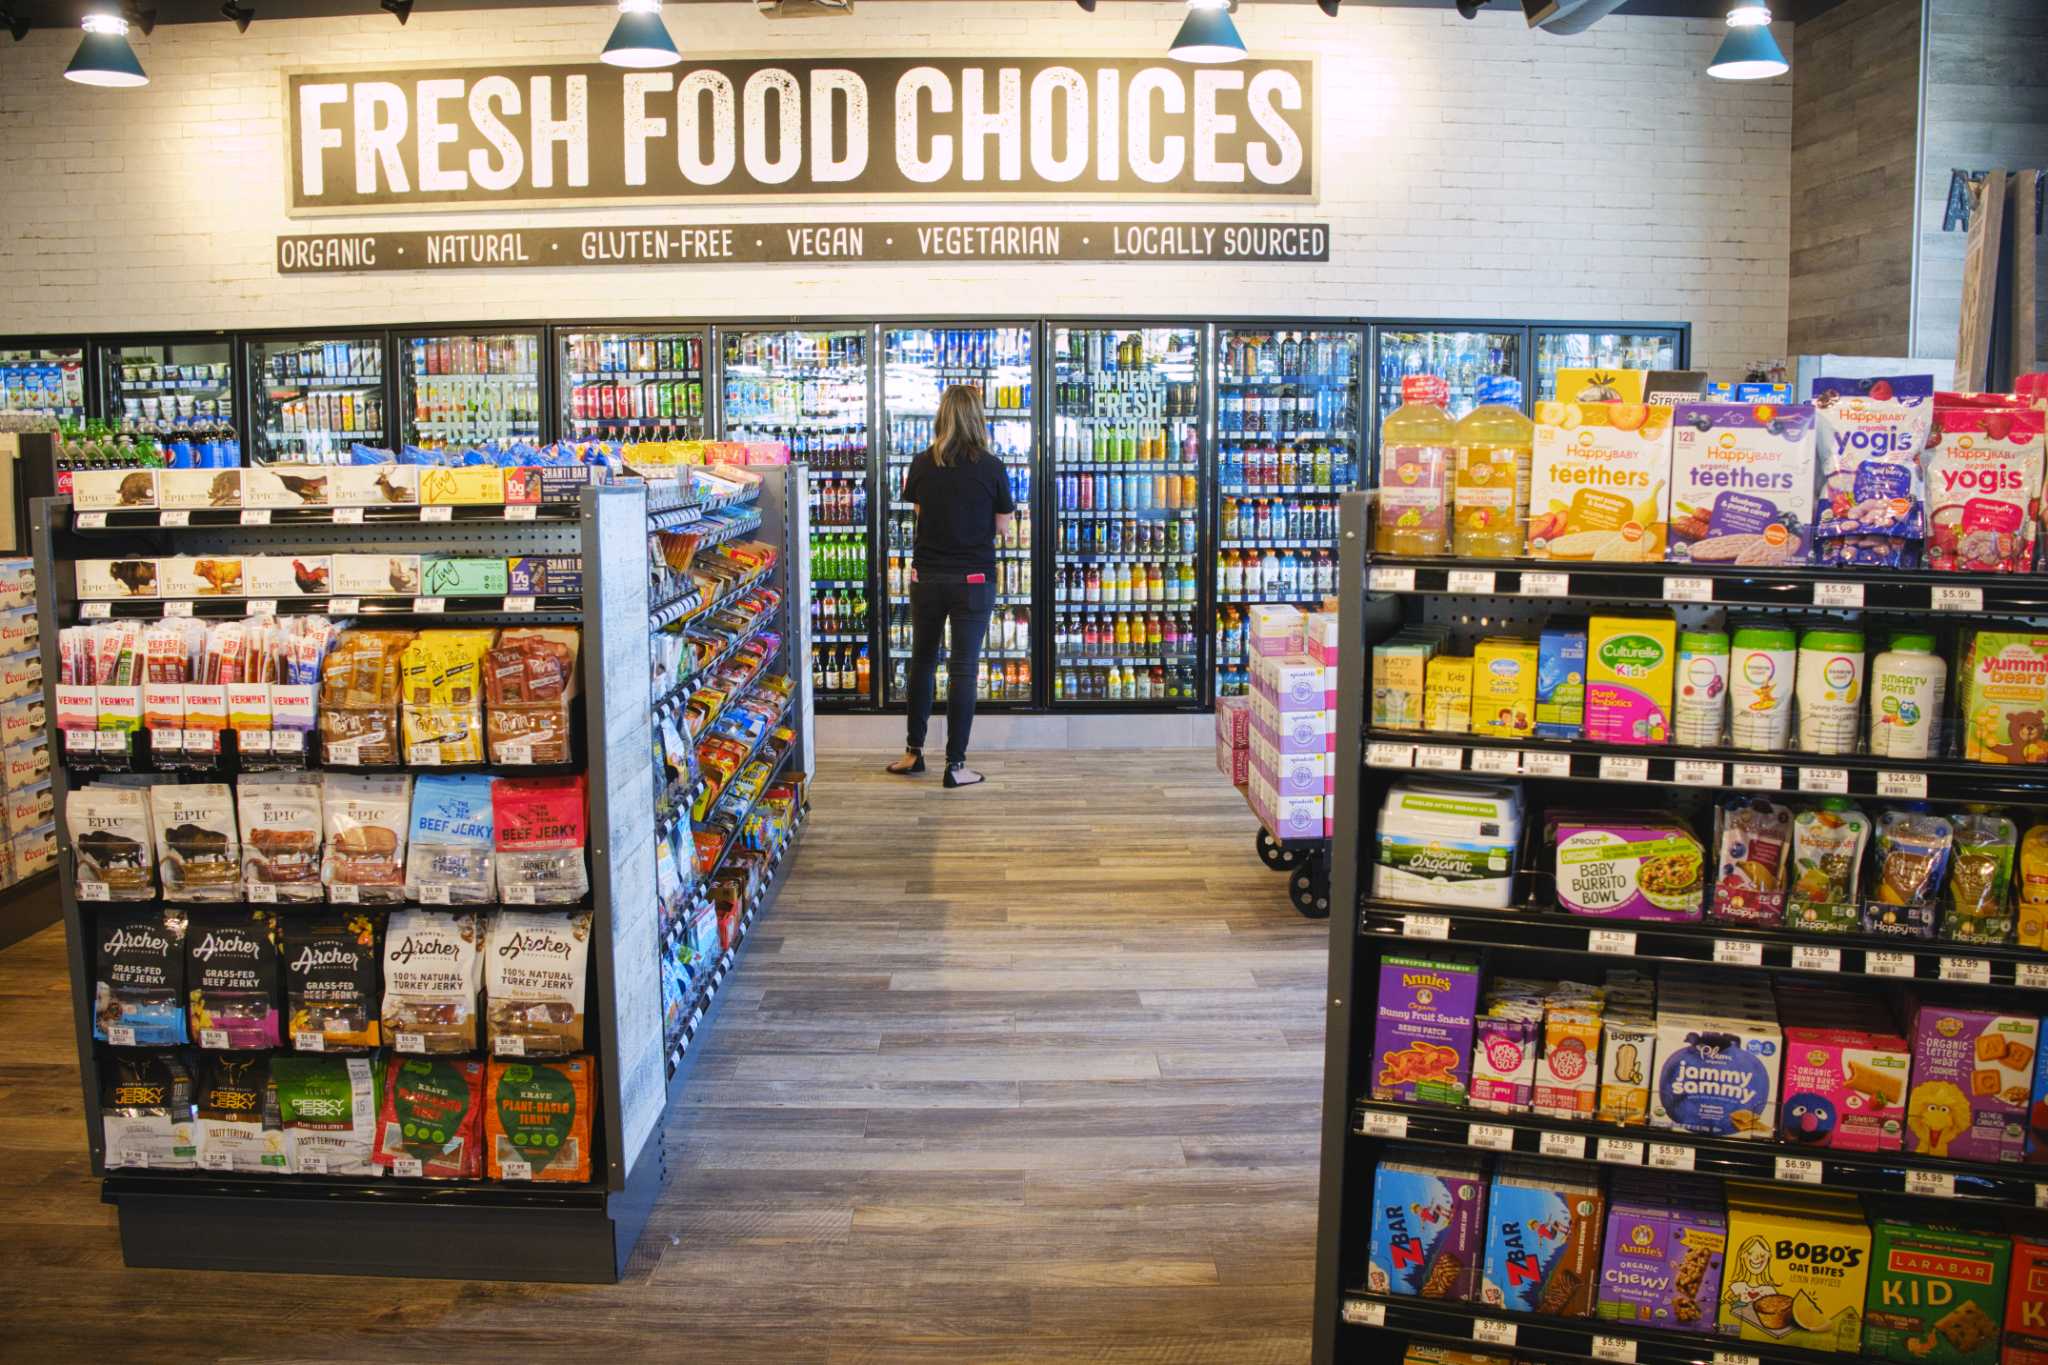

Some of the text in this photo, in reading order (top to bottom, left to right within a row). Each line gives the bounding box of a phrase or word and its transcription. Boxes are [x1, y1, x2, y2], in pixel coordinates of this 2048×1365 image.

[300, 67, 1303, 195] FRESH FOOD CHOICES
[281, 226, 1325, 268] ORGANIC NATURAL GLUTEN-FREE VEGAN VEGETARIAN LOCALLY SOURCED
[1095, 370, 1161, 391] IN HERE
[1094, 392, 1161, 418] FRESH
[1094, 419, 1161, 440] IS GOOD
[1833, 425, 1913, 457] yogis
[542, 467, 588, 479] SHANTI BAR
[1549, 464, 1649, 486] teethers
[1689, 466, 1793, 488] teethers
[1941, 463, 2023, 494] yogis
[507, 480, 525, 496] 10g
[547, 559, 575, 571] SHANTI
[1824, 585, 1852, 594] $5.99
[1942, 590, 1970, 598] $5.99
[1602, 644, 1660, 659] Culturelle
[1615, 664, 1647, 678] Kids
[1881, 674, 1927, 686] SMARTY
[1990, 671, 2046, 685] bears
[1881, 684, 1915, 695] PANTS
[1887, 773, 1922, 783] $24.99
[174, 810, 209, 821] EPIC
[263, 811, 299, 822] EPIC
[347, 810, 384, 819] EPIC
[88, 818, 122, 828] EPIC
[419, 817, 493, 839] BEEF JERKY
[502, 824, 577, 841] BEEF JERKY
[1570, 838, 1600, 846] SPROUT
[1410, 854, 1472, 873] Organic
[1582, 889, 1621, 904] BOWL
[104, 928, 169, 956] Archer
[192, 933, 260, 961] Archer
[499, 932, 572, 960] Archer
[1725, 942, 1751, 952] $2.99
[391, 936, 460, 964] Archer
[1803, 948, 1829, 958] $2.99
[290, 946, 359, 975] Archer
[1951, 959, 1978, 969] $2.99
[113, 963, 161, 976] GRASS-FED
[205, 969, 255, 979] GRASS-FED
[503, 968, 573, 980] 100% NATURAL
[112, 973, 166, 985] BEEF JERKY
[202, 978, 260, 988] BEEF JERKY
[393, 972, 463, 982] 100% NATURAL
[501, 976, 574, 990] TURKEY JERKY
[1402, 973, 1451, 992] Annie's
[306, 982, 354, 990] GRASS-FED
[394, 981, 464, 990] TURKEY JERKY
[1380, 1007, 1470, 1025] Bunny Fruit Snacks
[1675, 1061, 1753, 1087] jammy
[115, 1087, 165, 1096] PERKY
[210, 1091, 256, 1101] PERKY
[1673, 1080, 1755, 1104] sammy
[115, 1096, 165, 1104] JERKY
[210, 1100, 256, 1109] JERKY
[291, 1099, 345, 1108] PERKY
[295, 1107, 345, 1116] JERKY
[1478, 1125, 1503, 1136] $1.99
[1550, 1134, 1575, 1144] $1.99
[1608, 1140, 1633, 1150] $2.99
[1659, 1145, 1684, 1156] $5.99
[1785, 1160, 1812, 1171] $6.99
[1915, 1173, 1943, 1183] $5.99
[1775, 1240, 1863, 1268] BOBO'S
[1619, 1261, 1659, 1272] ORGANIC
[1788, 1262, 1845, 1278] OAT BITES
[1895, 1256, 1986, 1277] LARABAR
[1604, 1269, 1669, 1290] Chewy
[1882, 1280, 1953, 1306] KID
[1483, 1321, 1507, 1331] $7.99
[1601, 1336, 1627, 1347] $5.99
[1723, 1353, 1749, 1365] $6.99
